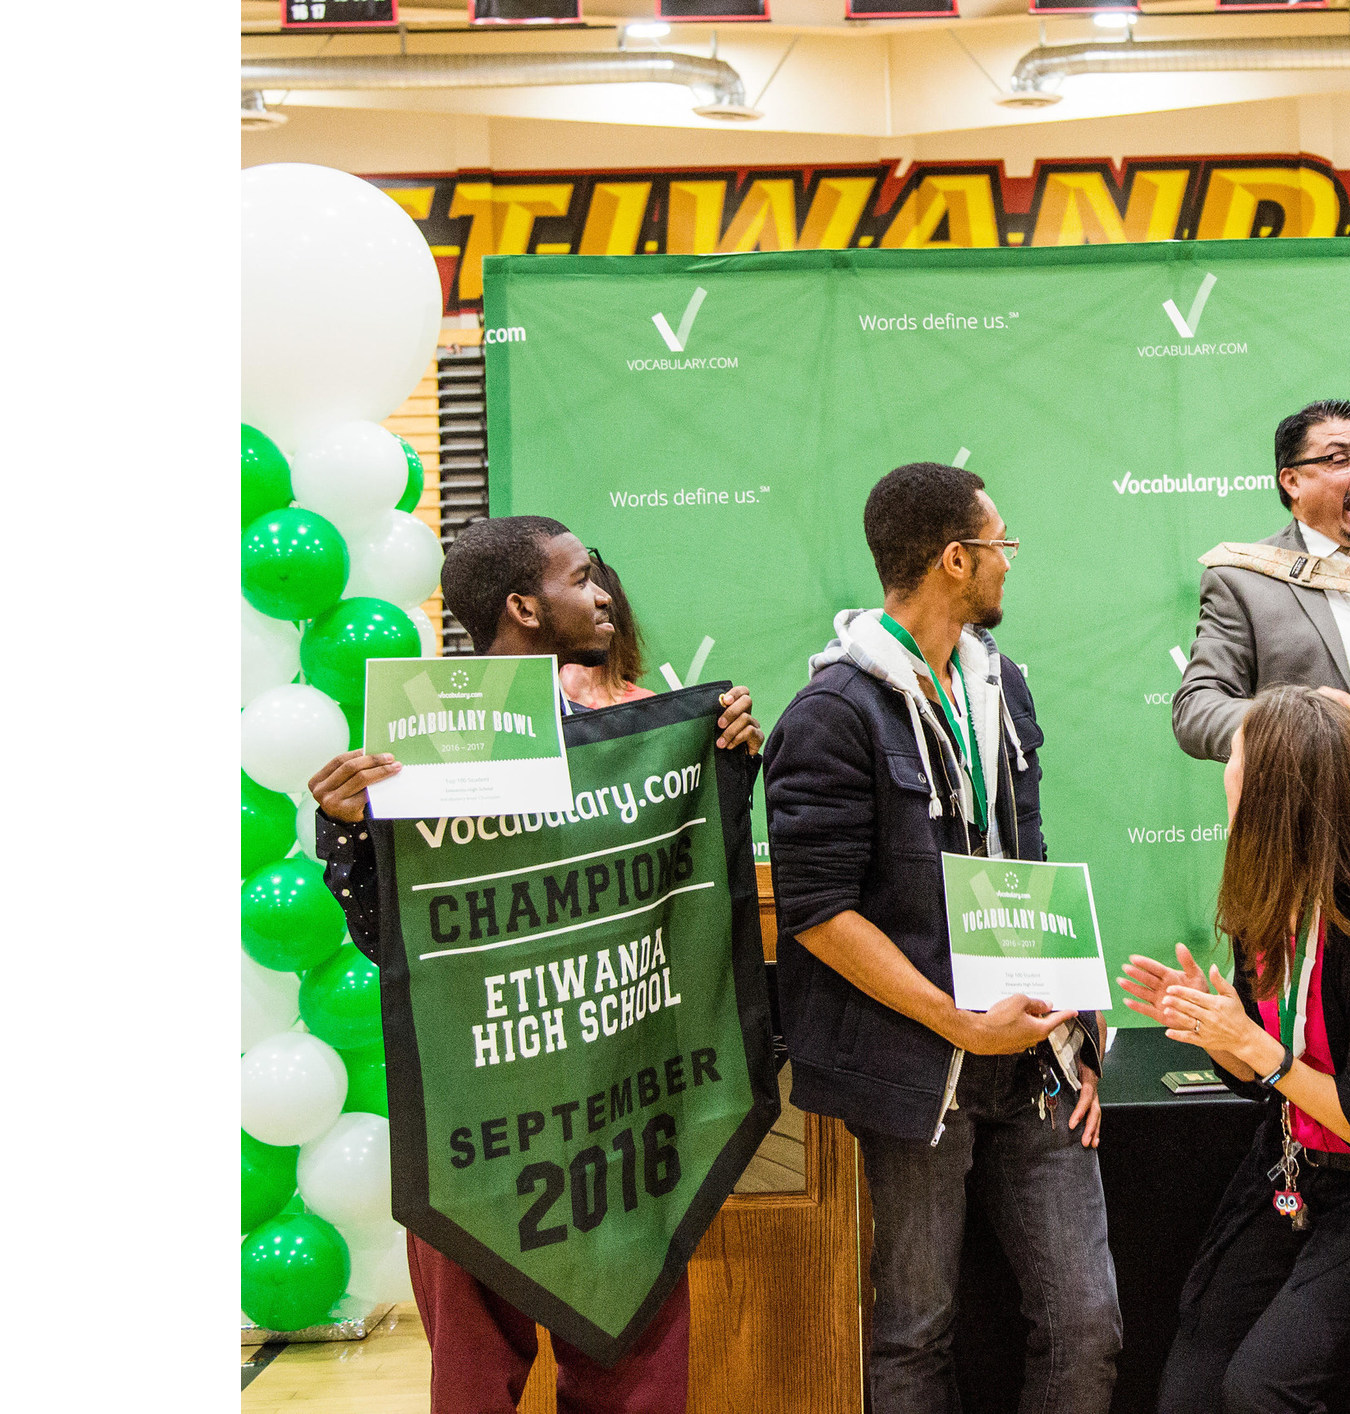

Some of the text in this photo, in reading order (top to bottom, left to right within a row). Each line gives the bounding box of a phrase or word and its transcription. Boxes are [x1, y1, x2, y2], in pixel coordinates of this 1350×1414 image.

[859, 313, 918, 331] Words
[922, 312, 978, 330] define
[1137, 342, 1248, 358] VOCABULARY.COM
[627, 357, 739, 371] VOCABULARY.COM
[1112, 470, 1275, 497] Vocabulary.com
[609, 489, 669, 508] Words
[673, 487, 729, 505] define
[388, 709, 537, 743] VOCABULARY BOWL
[441, 743, 460, 753] 2016
[467, 742, 485, 751] 2017
[1127, 825, 1186, 844] Words
[428, 834, 695, 944] CHAMPIONS
[962, 908, 1077, 939] VOCABULARY BOWL
[1002, 940, 1036, 948] 2016 2017
[484, 926, 667, 1019] ETIWANDA
[472, 967, 682, 1068] HIGH SCHOOL
[449, 1046, 724, 1170] SEPTEMBER
[516, 1112, 683, 1253] 2016
